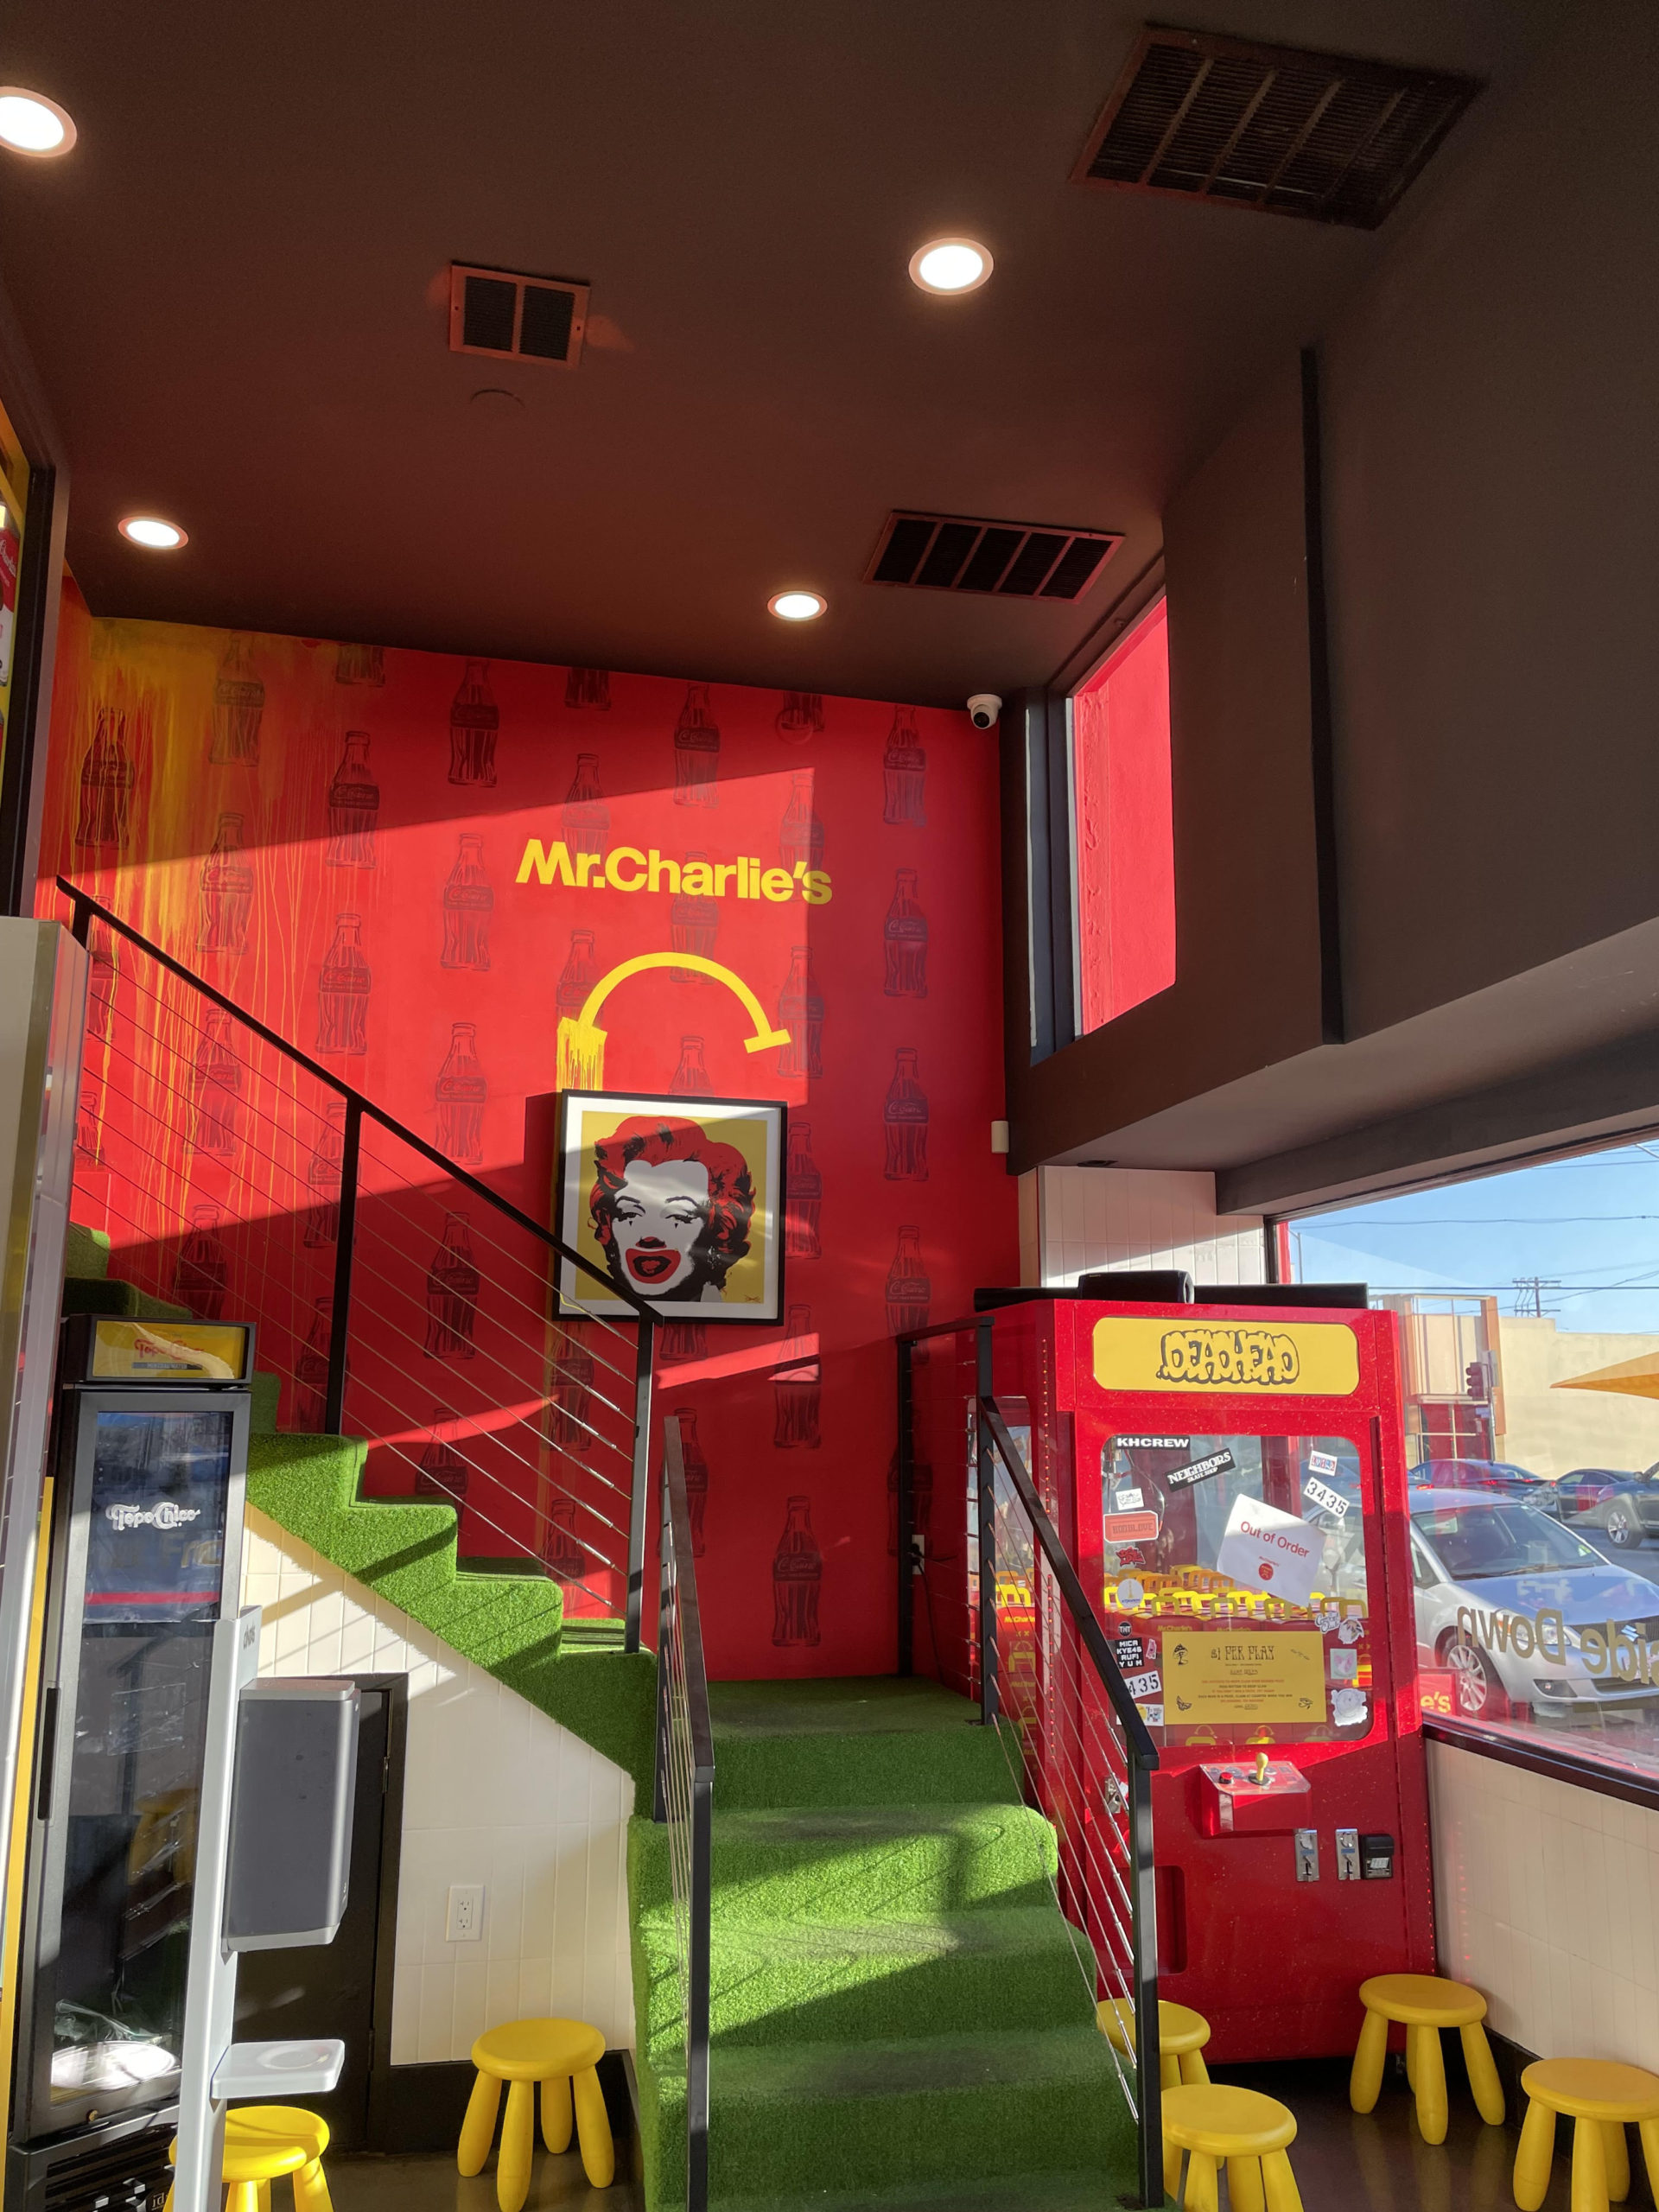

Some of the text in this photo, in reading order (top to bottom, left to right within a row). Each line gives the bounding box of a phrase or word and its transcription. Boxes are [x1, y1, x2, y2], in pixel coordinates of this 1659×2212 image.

[515, 838, 832, 905] Mr.Charlie's
[1117, 1437, 1189, 1448] KHCREW
[1167, 1452, 1232, 1484] NEIGHBORS
[1306, 1481, 1348, 1515] 3435
[105, 1502, 201, 1530] Topo Chico
[1240, 1521, 1310, 1558] Out of Order
[1224, 1645, 1245, 1661] PER
[1248, 1645, 1274, 1661] PLAY
[1128, 1674, 1159, 1695] 435
